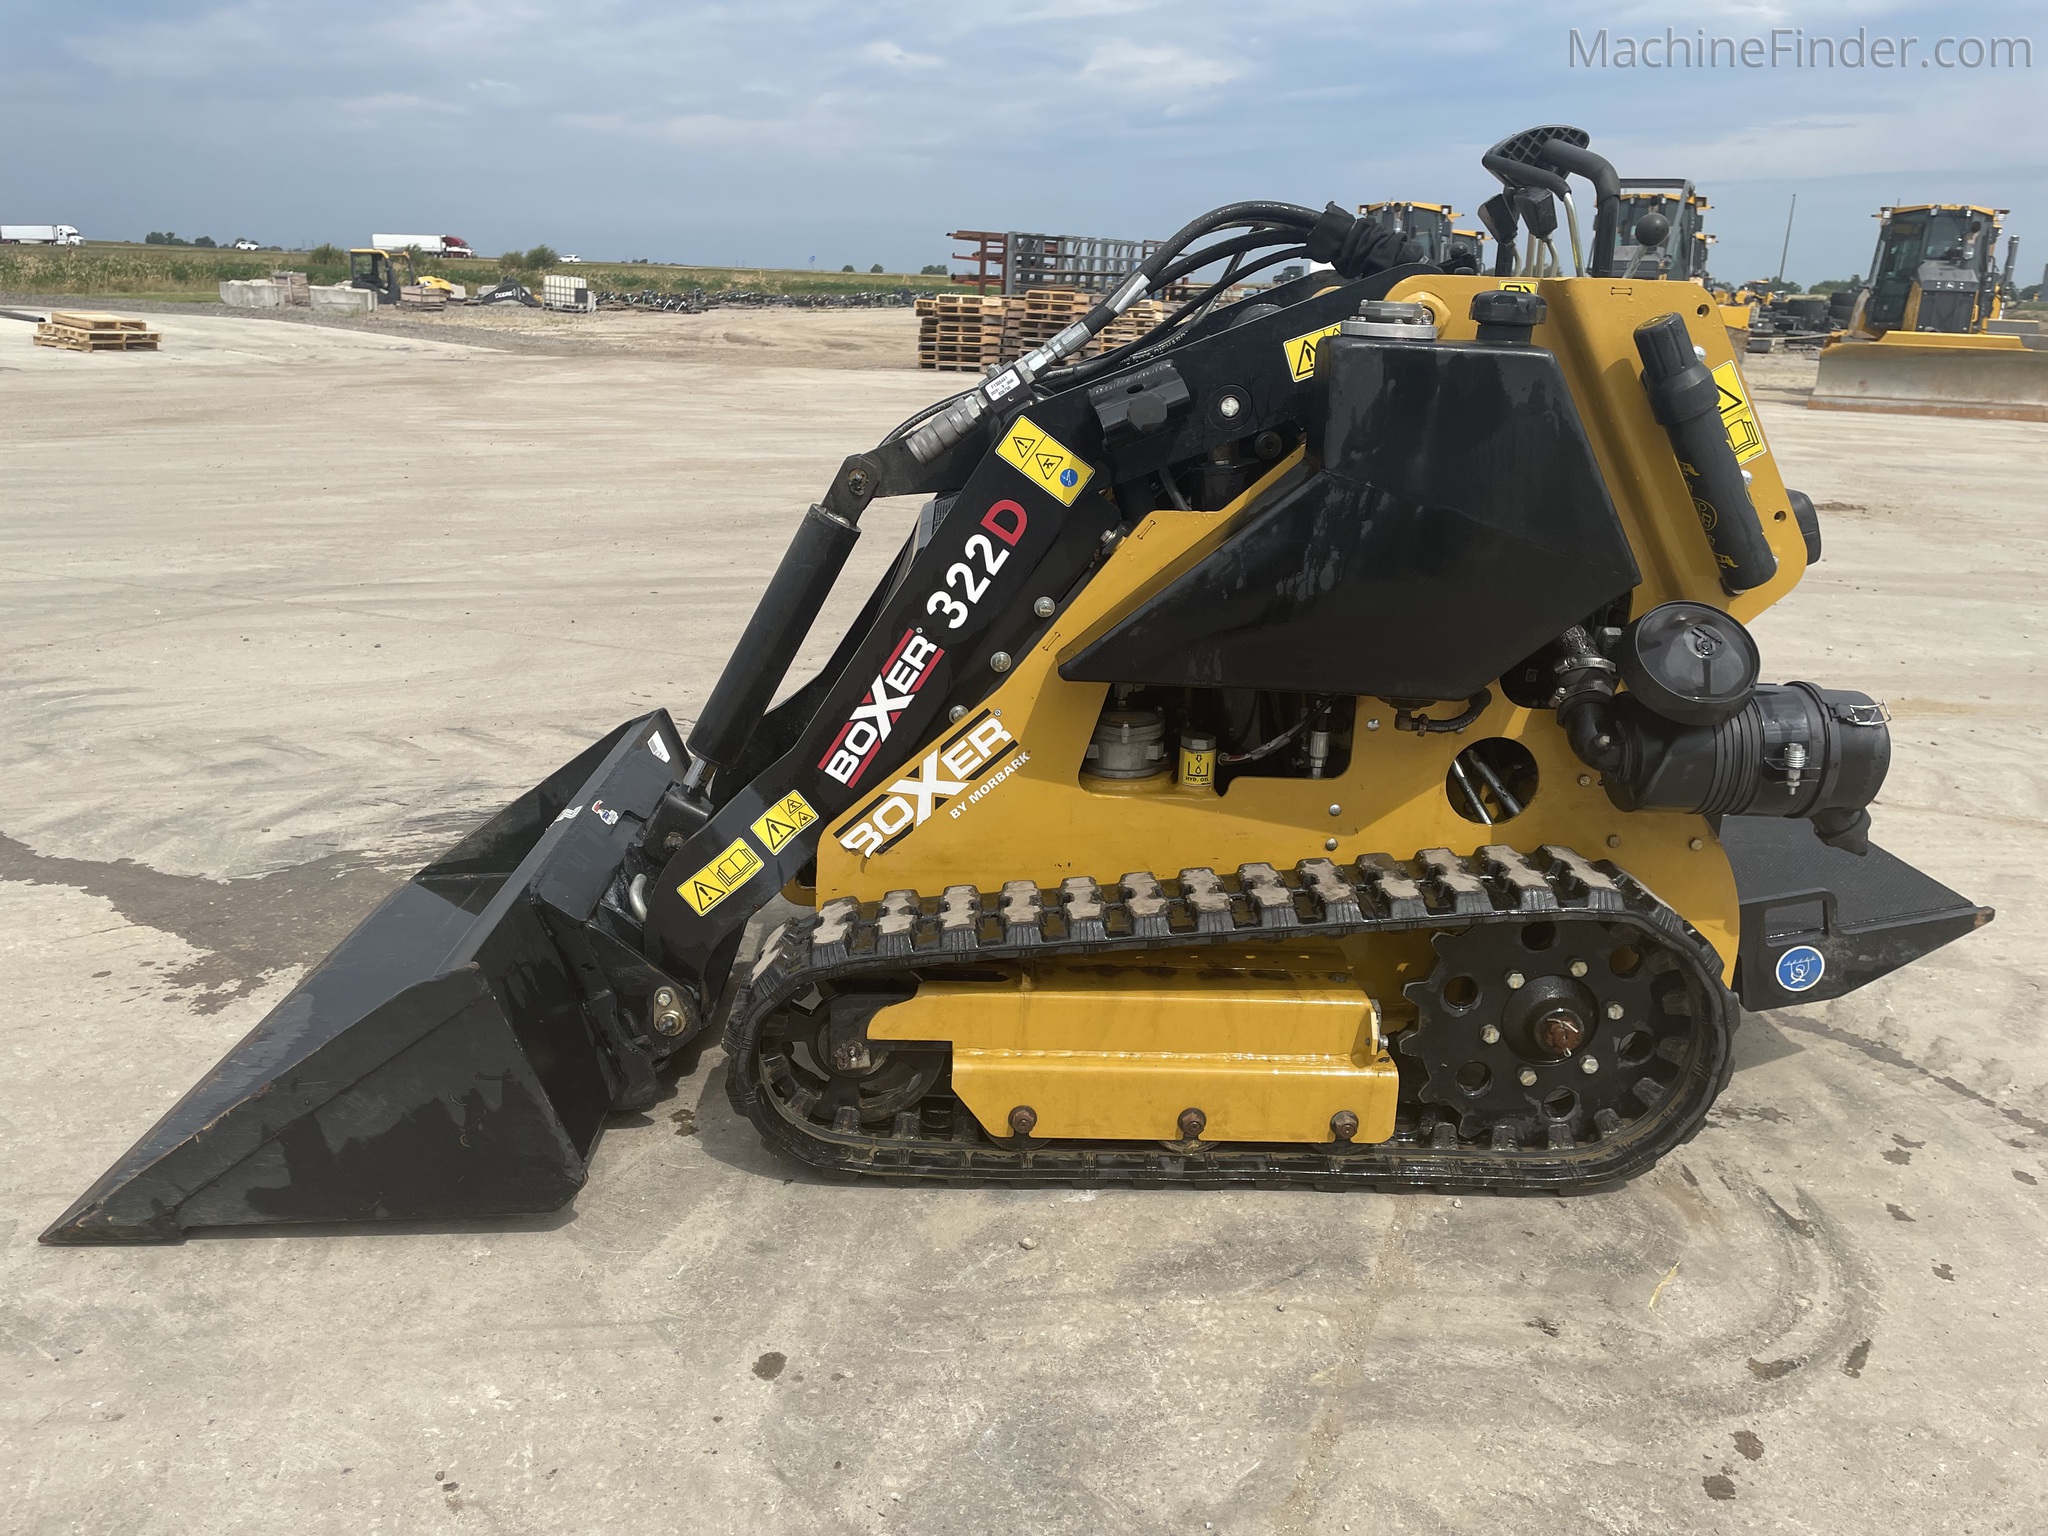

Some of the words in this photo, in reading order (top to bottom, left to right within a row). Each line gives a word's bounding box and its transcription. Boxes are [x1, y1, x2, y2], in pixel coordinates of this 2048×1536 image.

[824, 634, 938, 785] BOXER
[926, 499, 1028, 629] 322D
[839, 717, 1013, 860] BOXER
[949, 801, 967, 820] BY
[968, 751, 1031, 804] MORBARK
